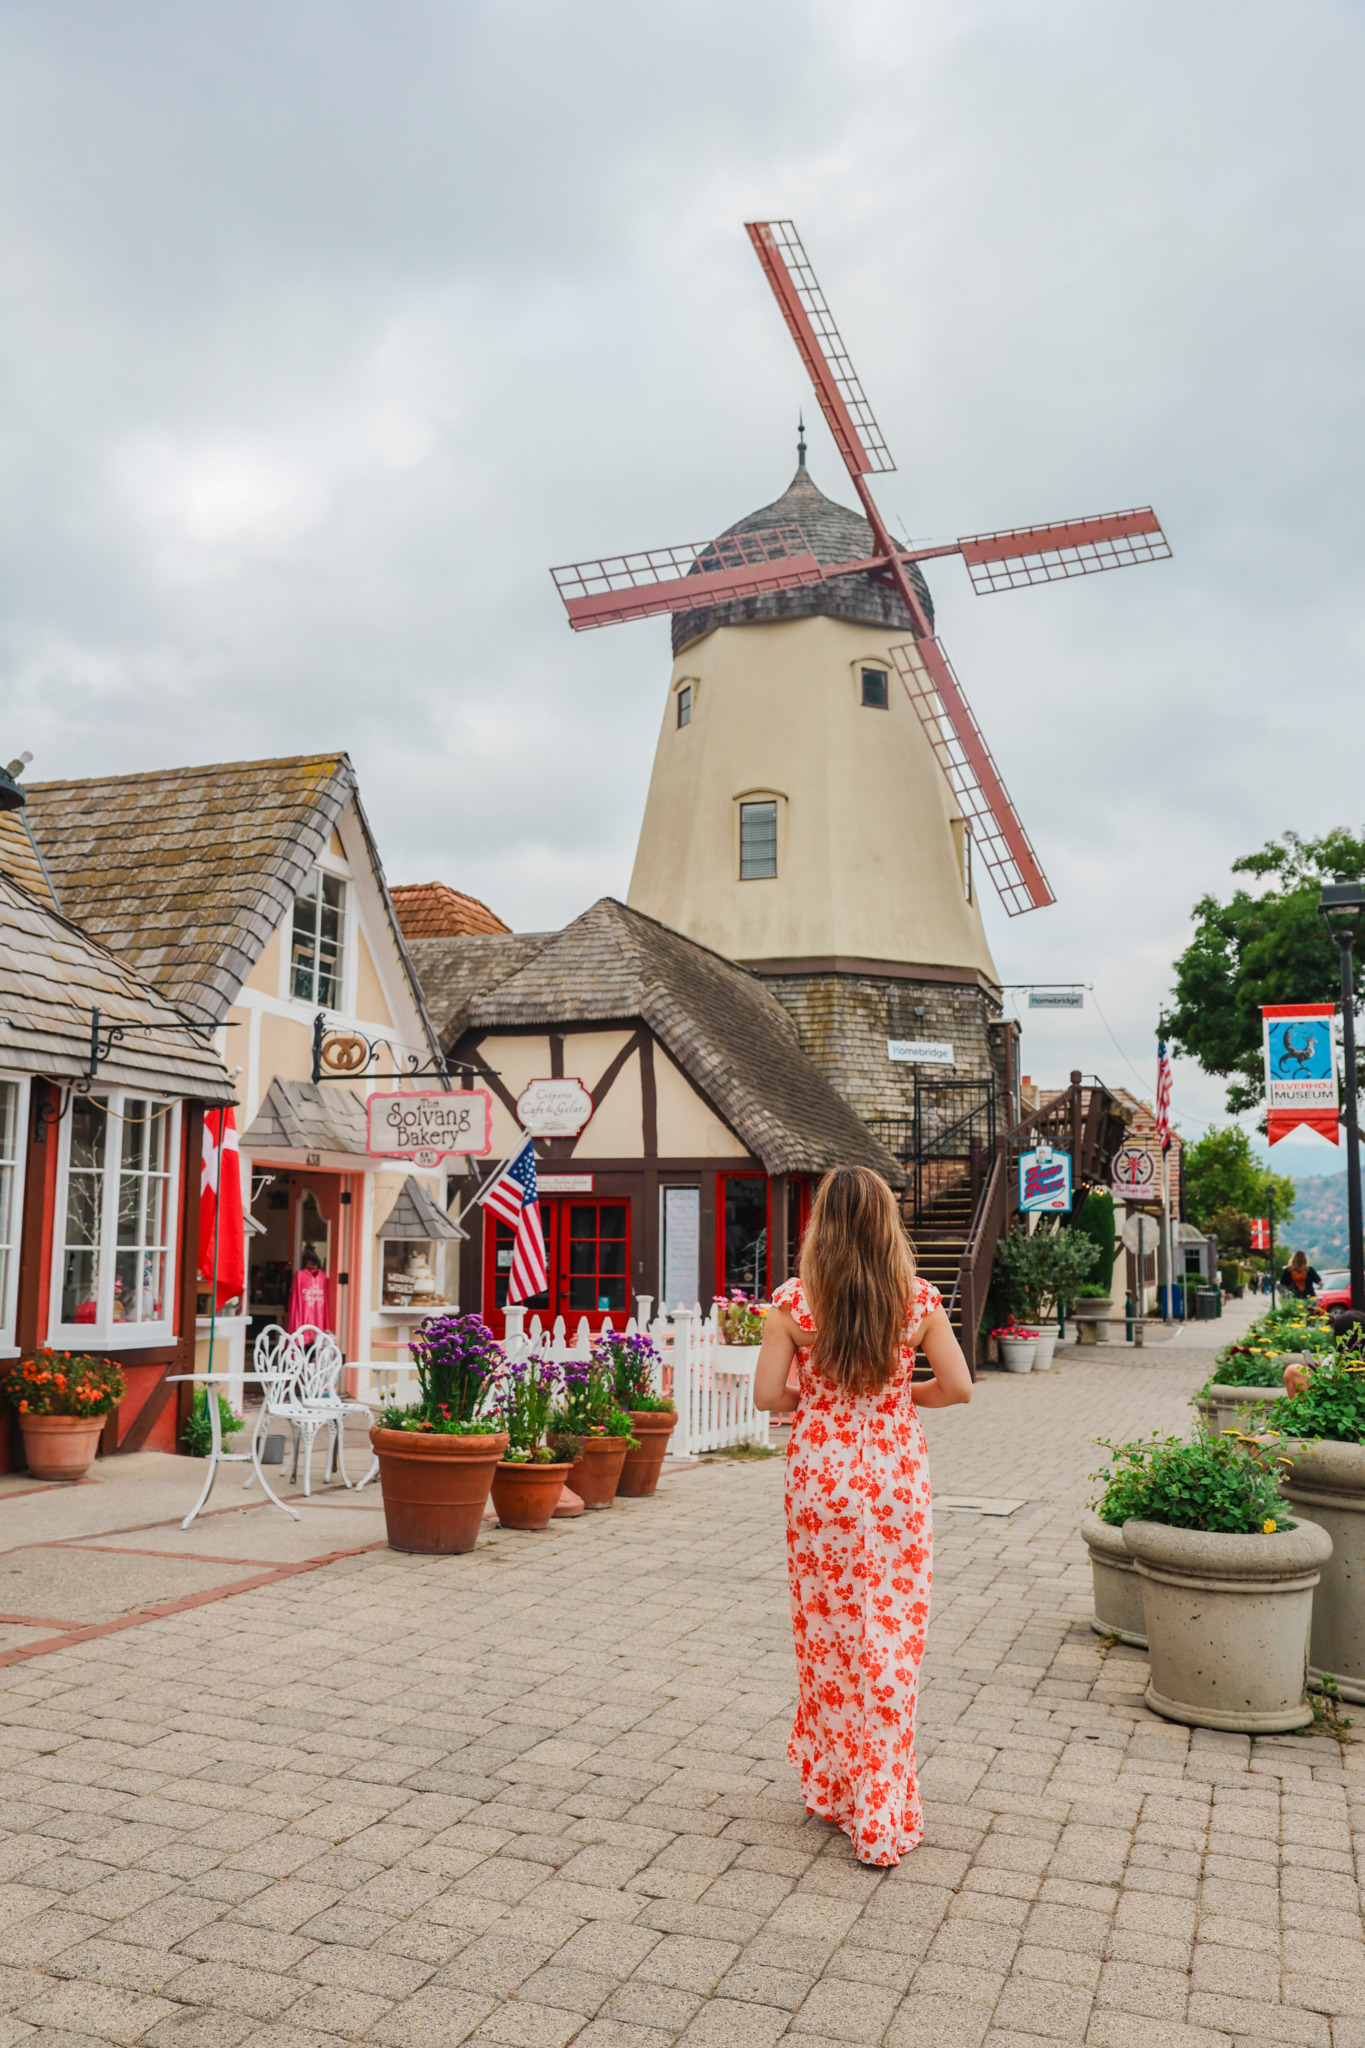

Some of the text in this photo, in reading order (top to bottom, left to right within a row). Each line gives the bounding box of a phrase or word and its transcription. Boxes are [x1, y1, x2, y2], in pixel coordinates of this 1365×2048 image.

[1031, 996, 1079, 1005] Homebridge
[892, 1046, 948, 1059] Homebridge
[1274, 1082, 1333, 1090] ELVERHØJ
[1274, 1091, 1333, 1099] MUSEUM
[420, 1098, 440, 1109] The
[553, 1099, 588, 1116] Gelato
[386, 1102, 471, 1132] Solvang
[397, 1126, 459, 1150] Bakery
